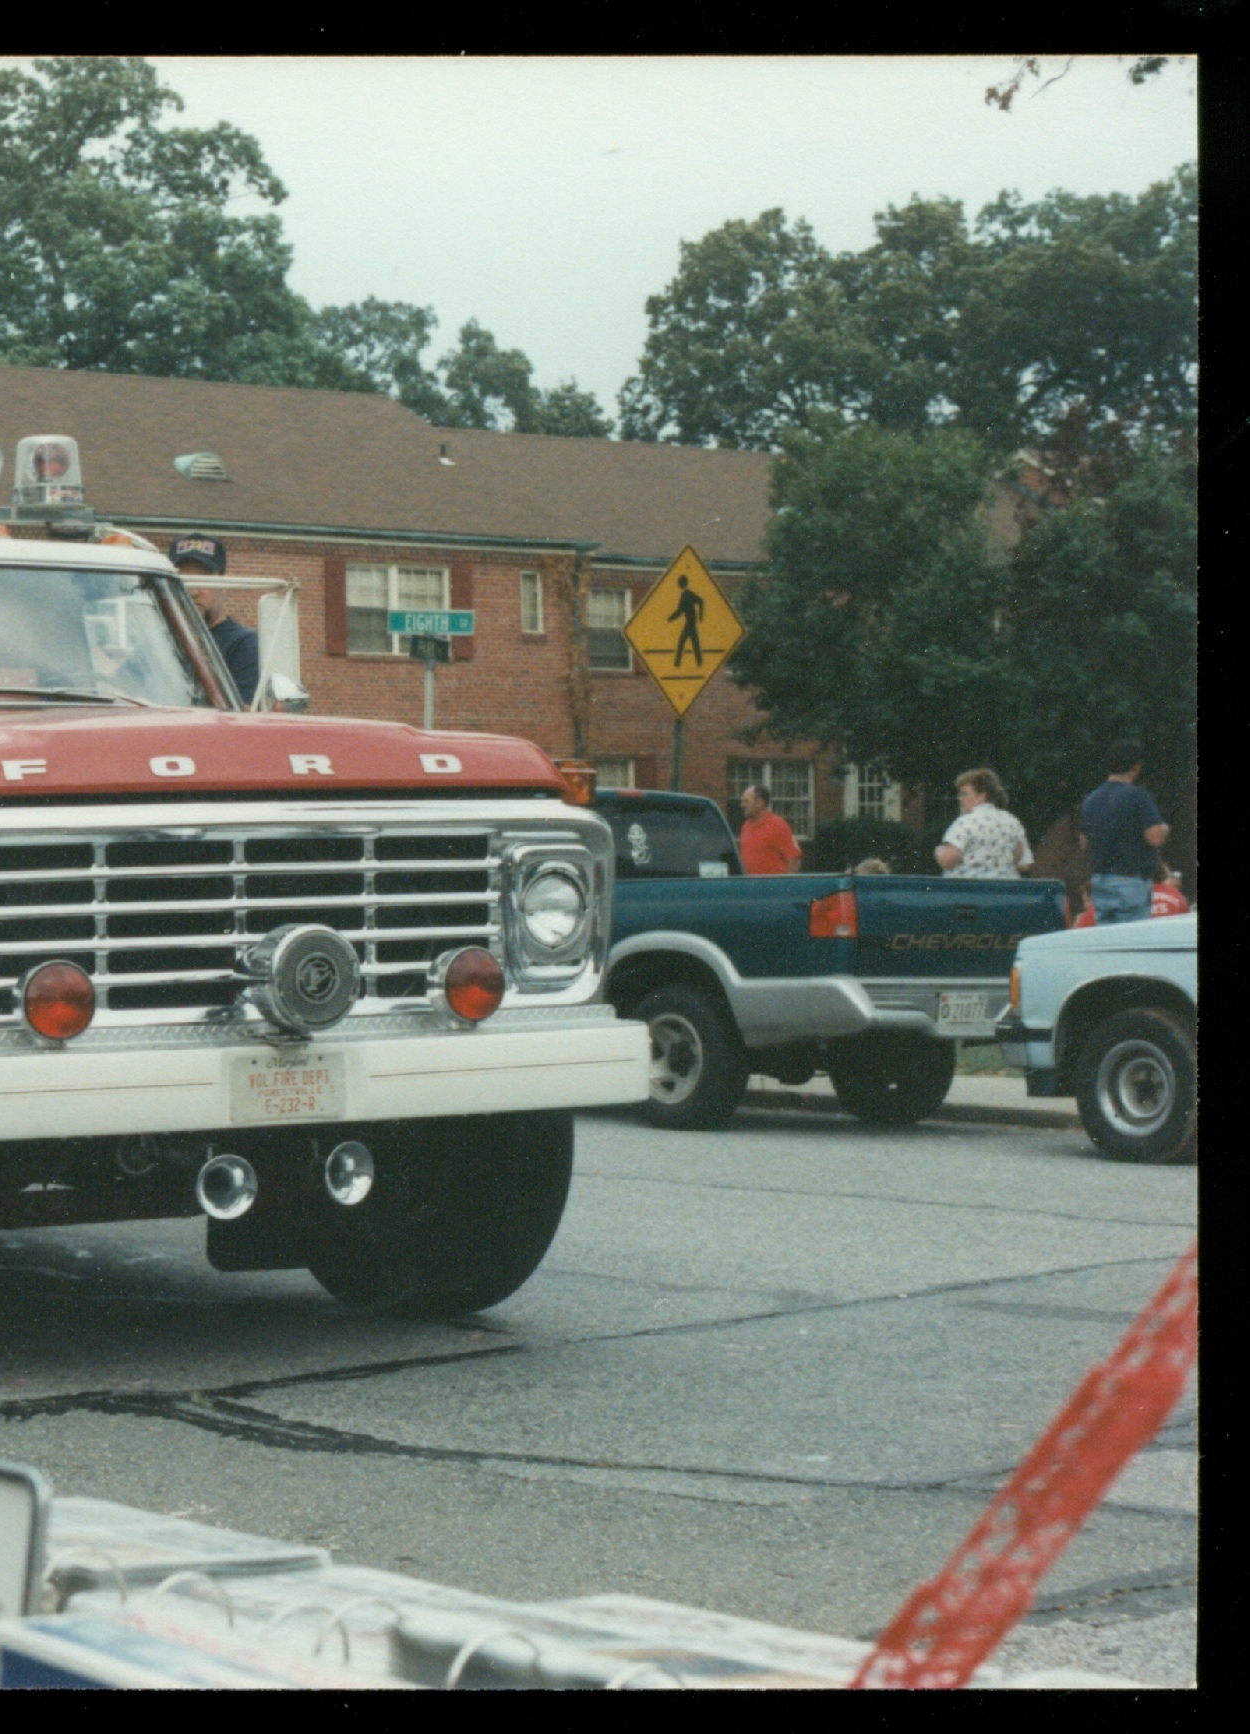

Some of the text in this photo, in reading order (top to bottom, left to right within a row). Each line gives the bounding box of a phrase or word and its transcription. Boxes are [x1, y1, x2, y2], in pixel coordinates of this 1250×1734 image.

[405, 612, 449, 632] EIGHTH
[1, 753, 463, 781] FORD
[892, 933, 1038, 949] CHEVROLE
[272, 1070, 298, 1087] FIRE
